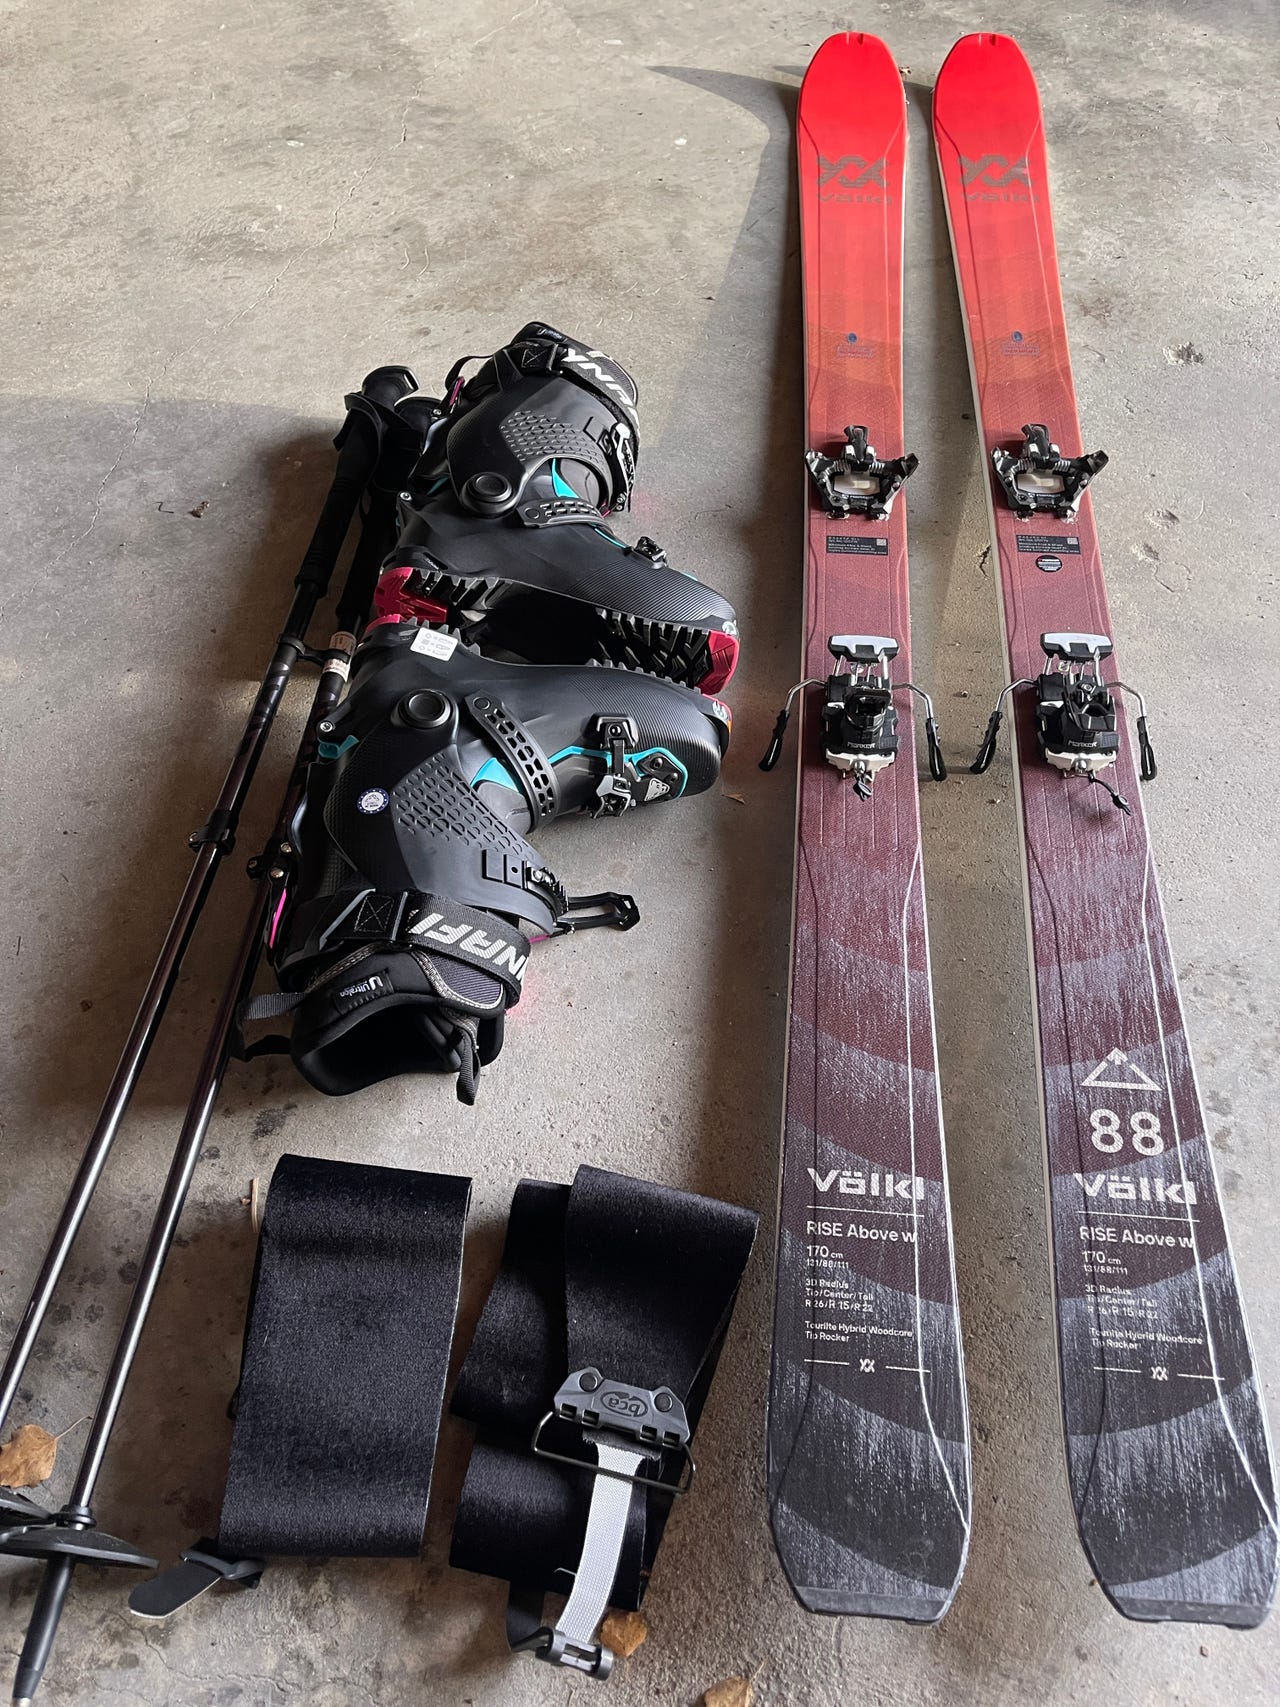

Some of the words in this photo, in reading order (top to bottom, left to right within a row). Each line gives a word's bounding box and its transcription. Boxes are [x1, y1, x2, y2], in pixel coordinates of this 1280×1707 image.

[1090, 1108, 1164, 1156] 88
[807, 1168, 925, 1200] Völkl
[1073, 1172, 1198, 1205] Völkl
[806, 1220, 843, 1237] RISE
[847, 1224, 898, 1241] Above
[1079, 1226, 1118, 1243] RISE
[1122, 1229, 1176, 1247] Above
[806, 1245, 829, 1258] 170
[1082, 1250, 1106, 1264] 170
[805, 1278, 817, 1287] 3D
[1085, 1284, 1097, 1293] 3D
[819, 1332, 850, 1342] Rocker
[838, 1323, 867, 1334] Hybrid
[868, 1326, 913, 1338] Woodcore
[608, 1398, 641, 1417] bca
